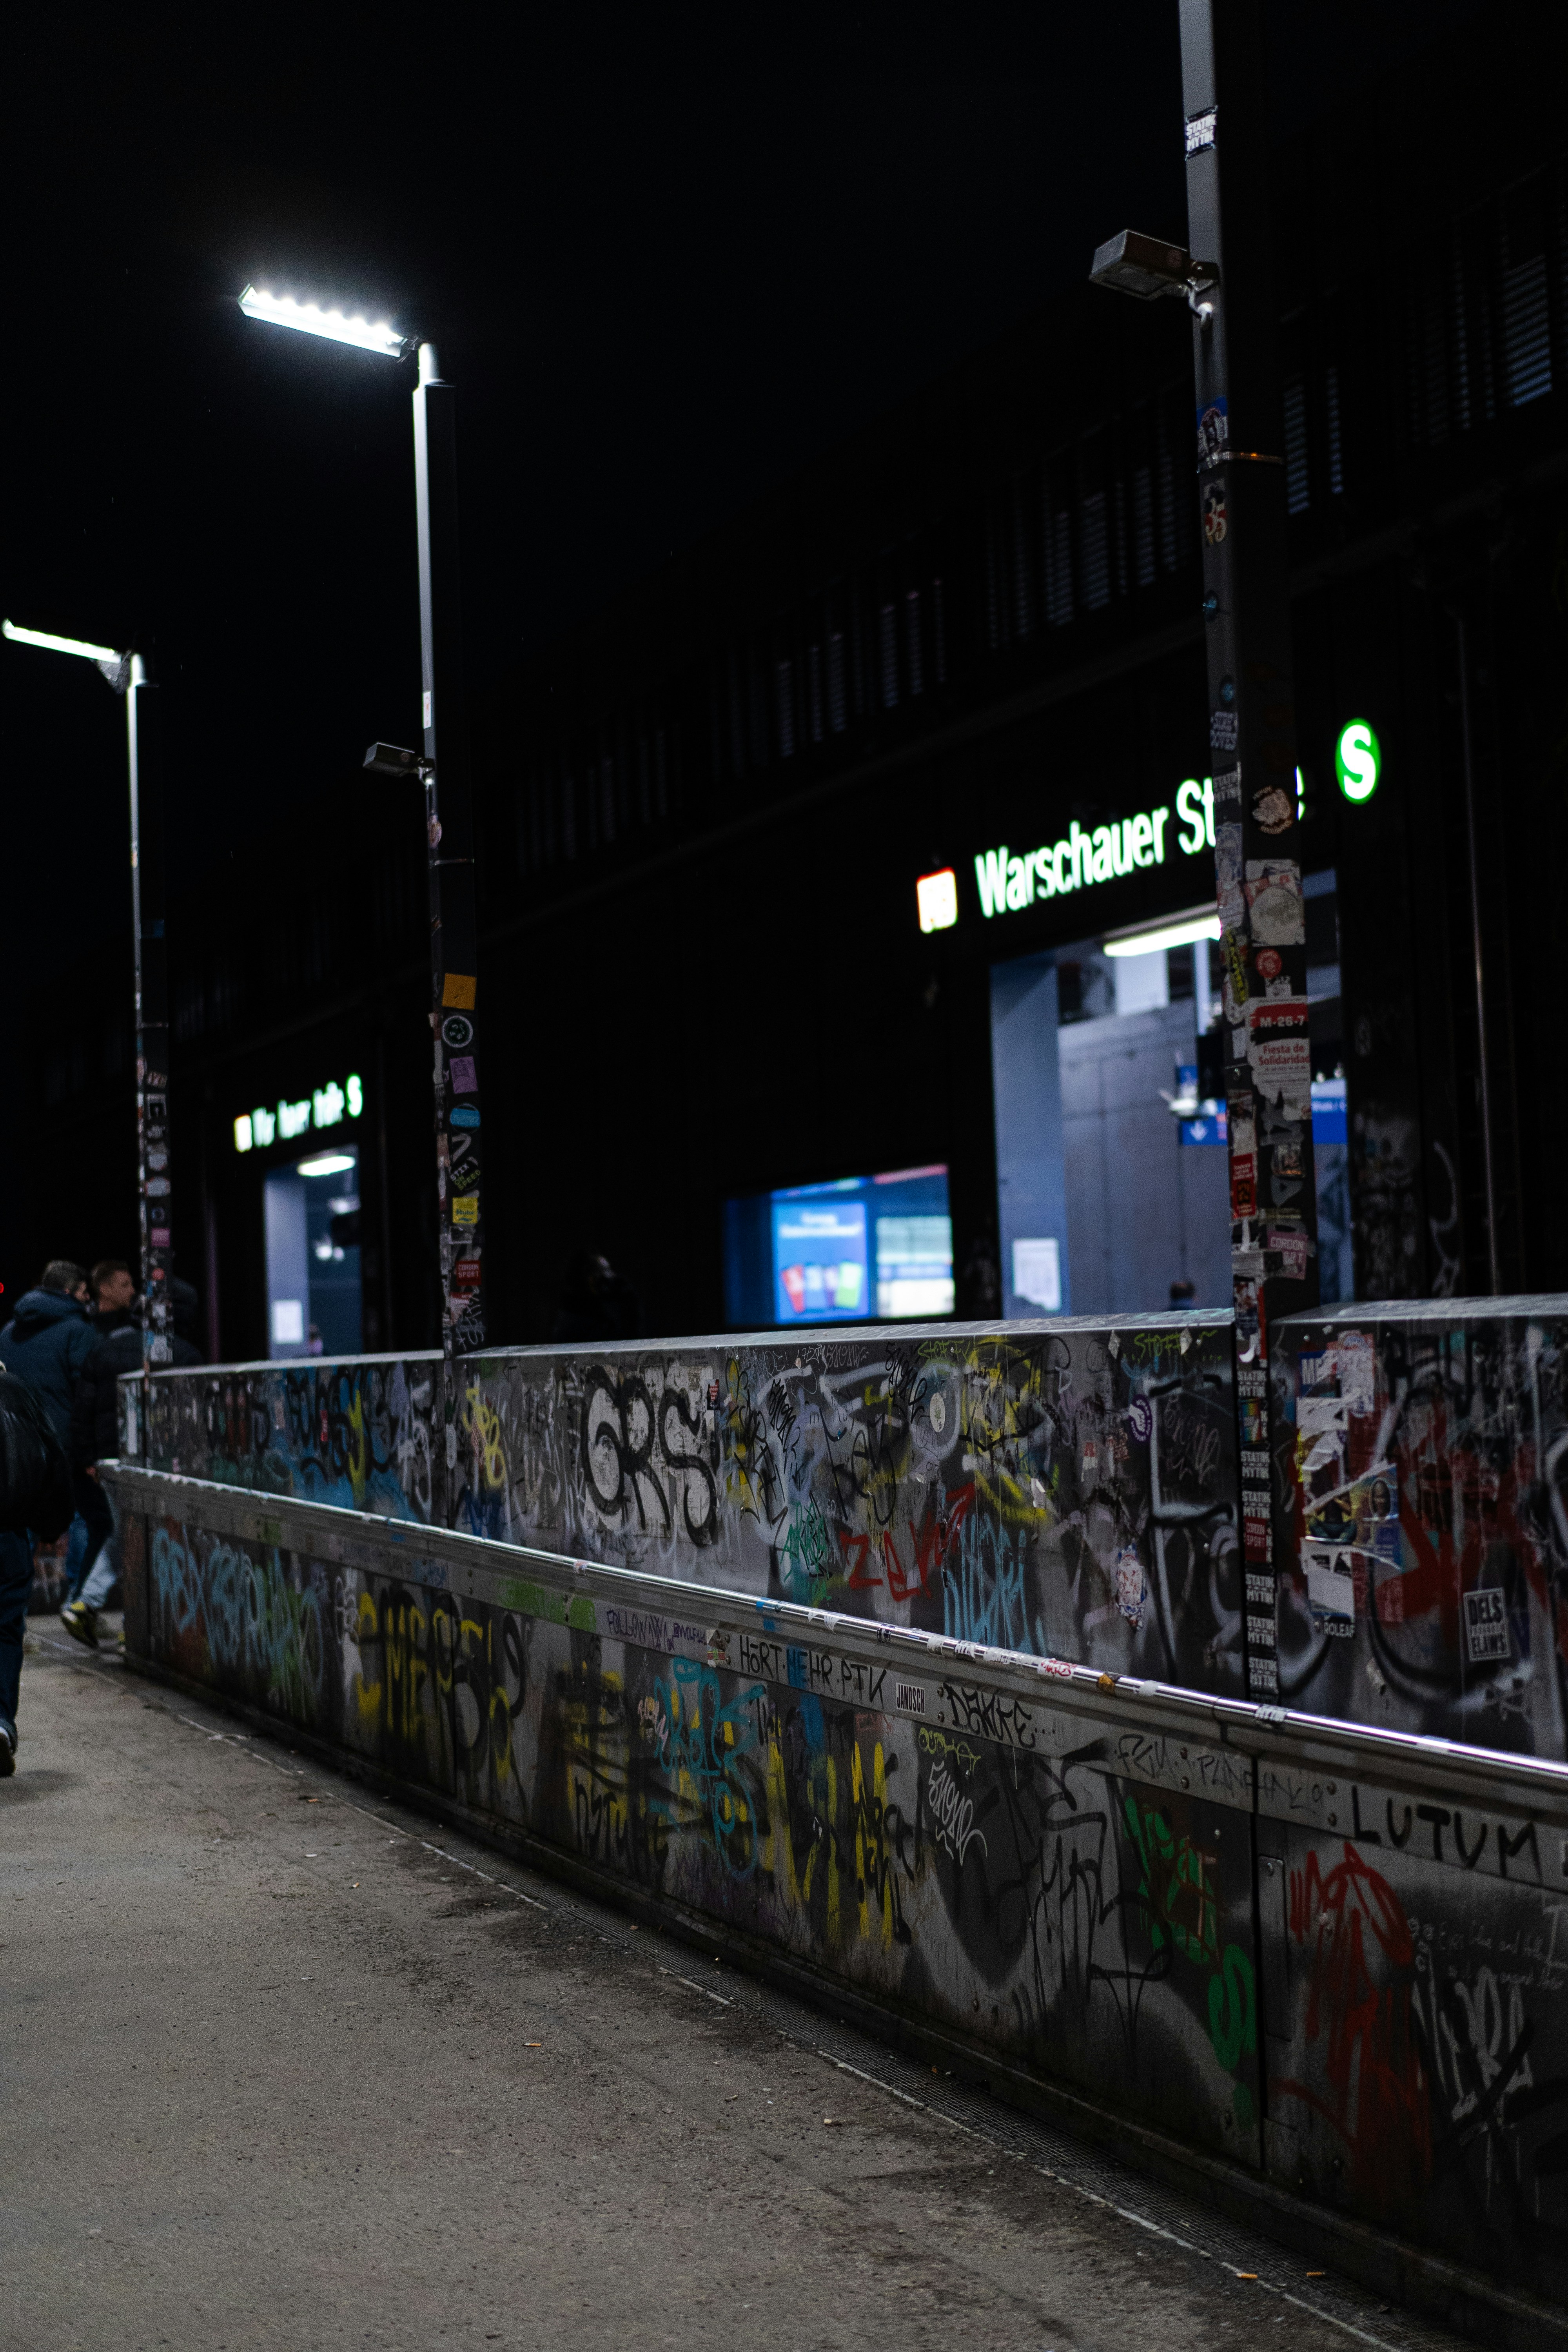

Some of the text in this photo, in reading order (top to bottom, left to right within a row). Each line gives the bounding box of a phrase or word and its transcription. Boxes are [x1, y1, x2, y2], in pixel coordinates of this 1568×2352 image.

[1341, 724, 1376, 799] S
[975, 806, 1169, 918] Warschauer
[1263, 1044, 1305, 1054] Fiesta de
[1246, 1535, 1265, 1547] SPORT
[897, 1684, 925, 1713] JANOSCH
